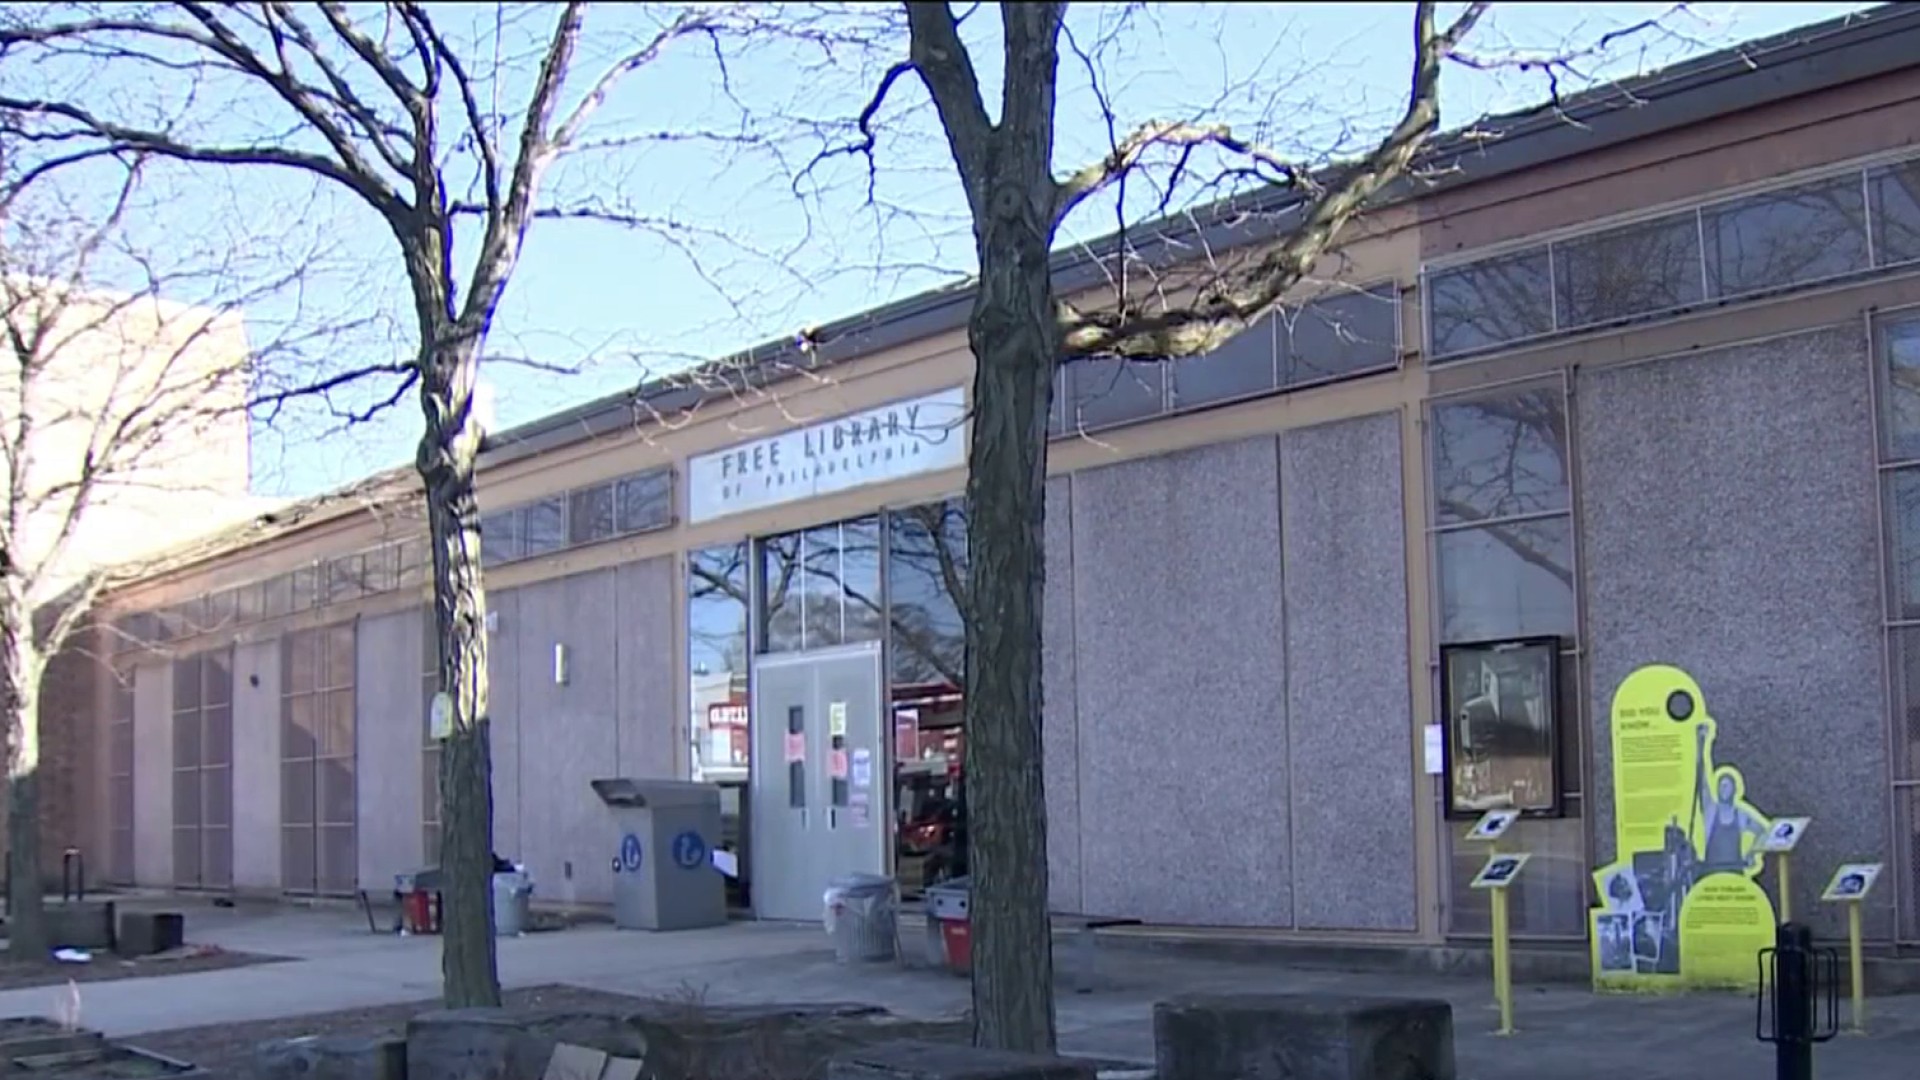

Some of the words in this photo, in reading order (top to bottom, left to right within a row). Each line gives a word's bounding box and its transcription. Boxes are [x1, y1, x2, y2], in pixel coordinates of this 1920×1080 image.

[721, 440, 781, 479] FREE
[803, 404, 920, 459] LIBRARY
[722, 483, 742, 500] OF
[765, 440, 920, 490] PHILADELPHIA
